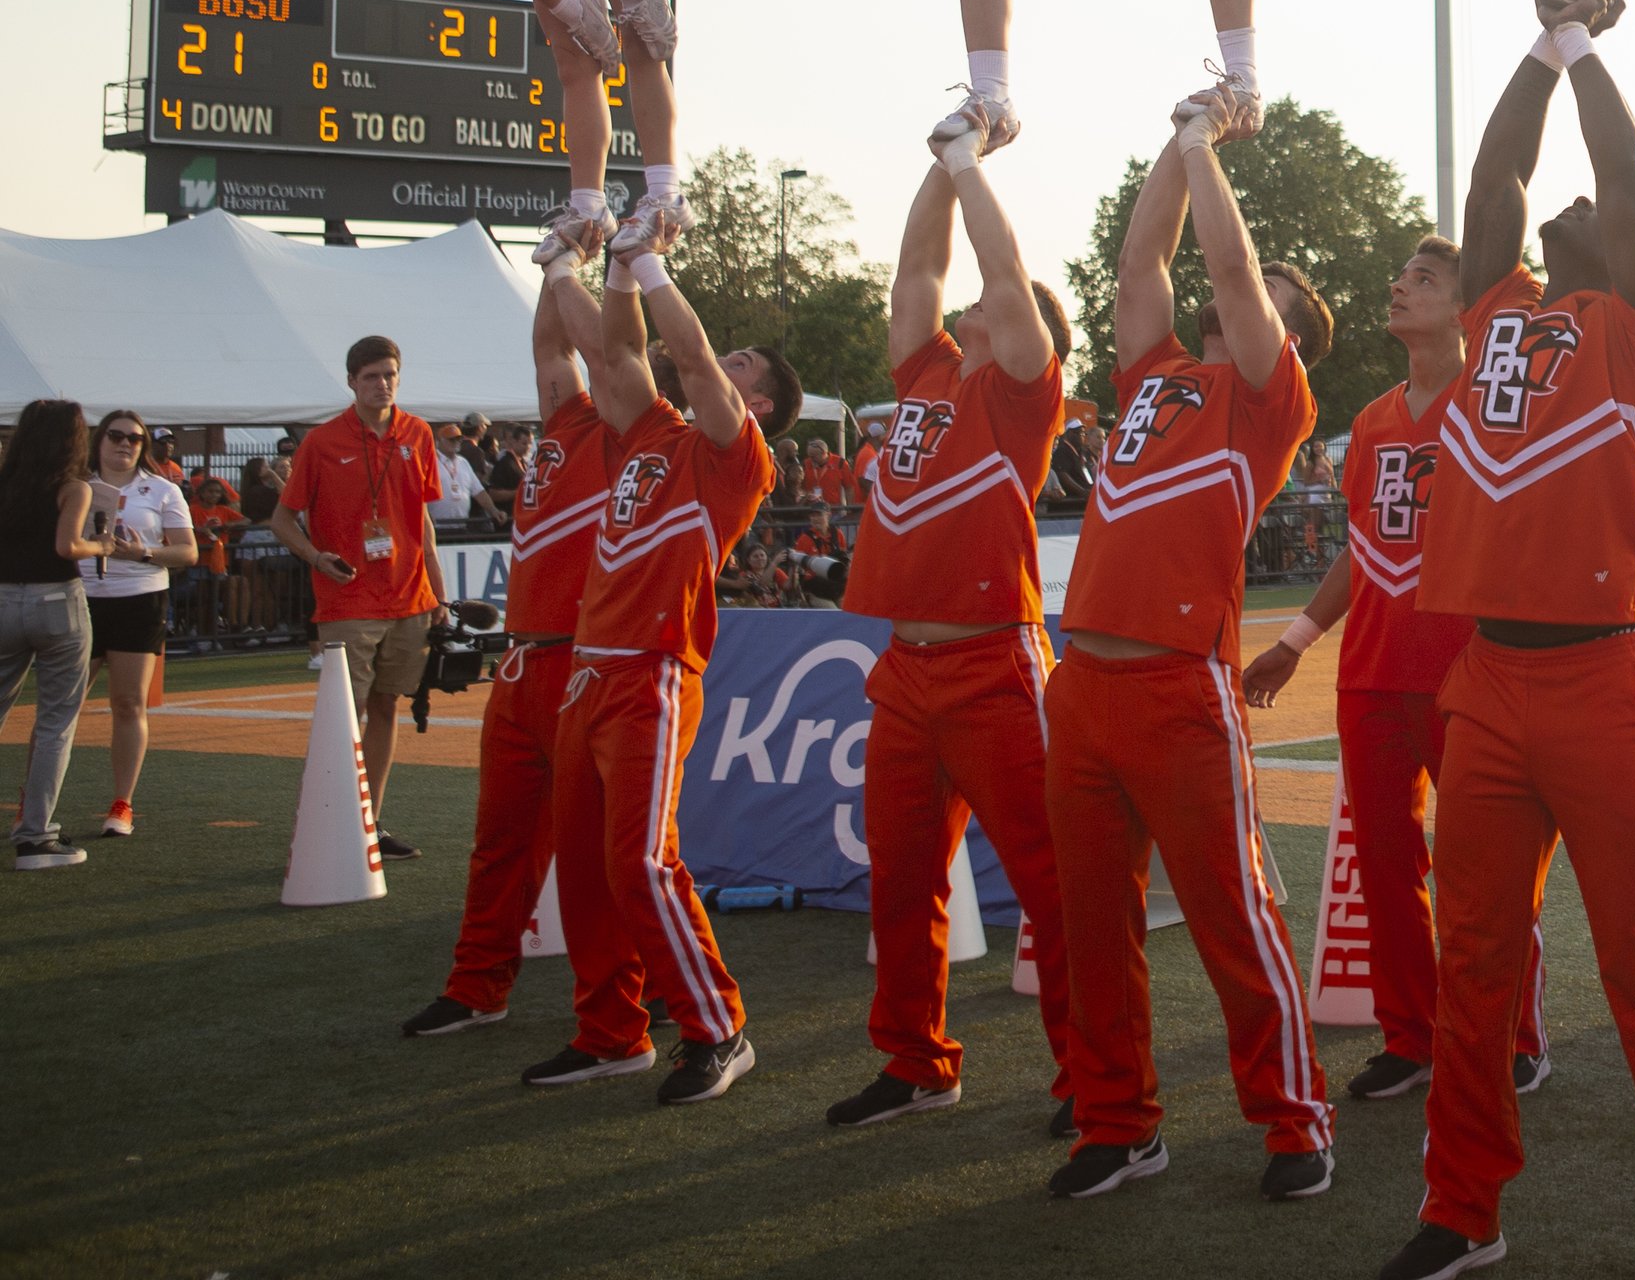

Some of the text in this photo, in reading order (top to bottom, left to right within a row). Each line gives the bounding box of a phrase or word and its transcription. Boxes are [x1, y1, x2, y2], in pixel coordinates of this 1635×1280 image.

[178, 23, 244, 75] 21
[312, 61, 376, 90] 0 T.O.L.
[487, 78, 543, 105] T.O.L. 2
[161, 97, 272, 135] 4 DOWN
[320, 106, 425, 143] 6 TO GO
[456, 117, 502, 148] BALL
[506, 121, 533, 149] ON
[392, 181, 467, 207] Official
[475, 185, 555, 217] Hospital
[1477, 317, 1529, 423] BG
[889, 403, 923, 474] BG
[1114, 376, 1164, 463] BG
[1372, 450, 1414, 535] BG
[710, 639, 876, 865] Kro
